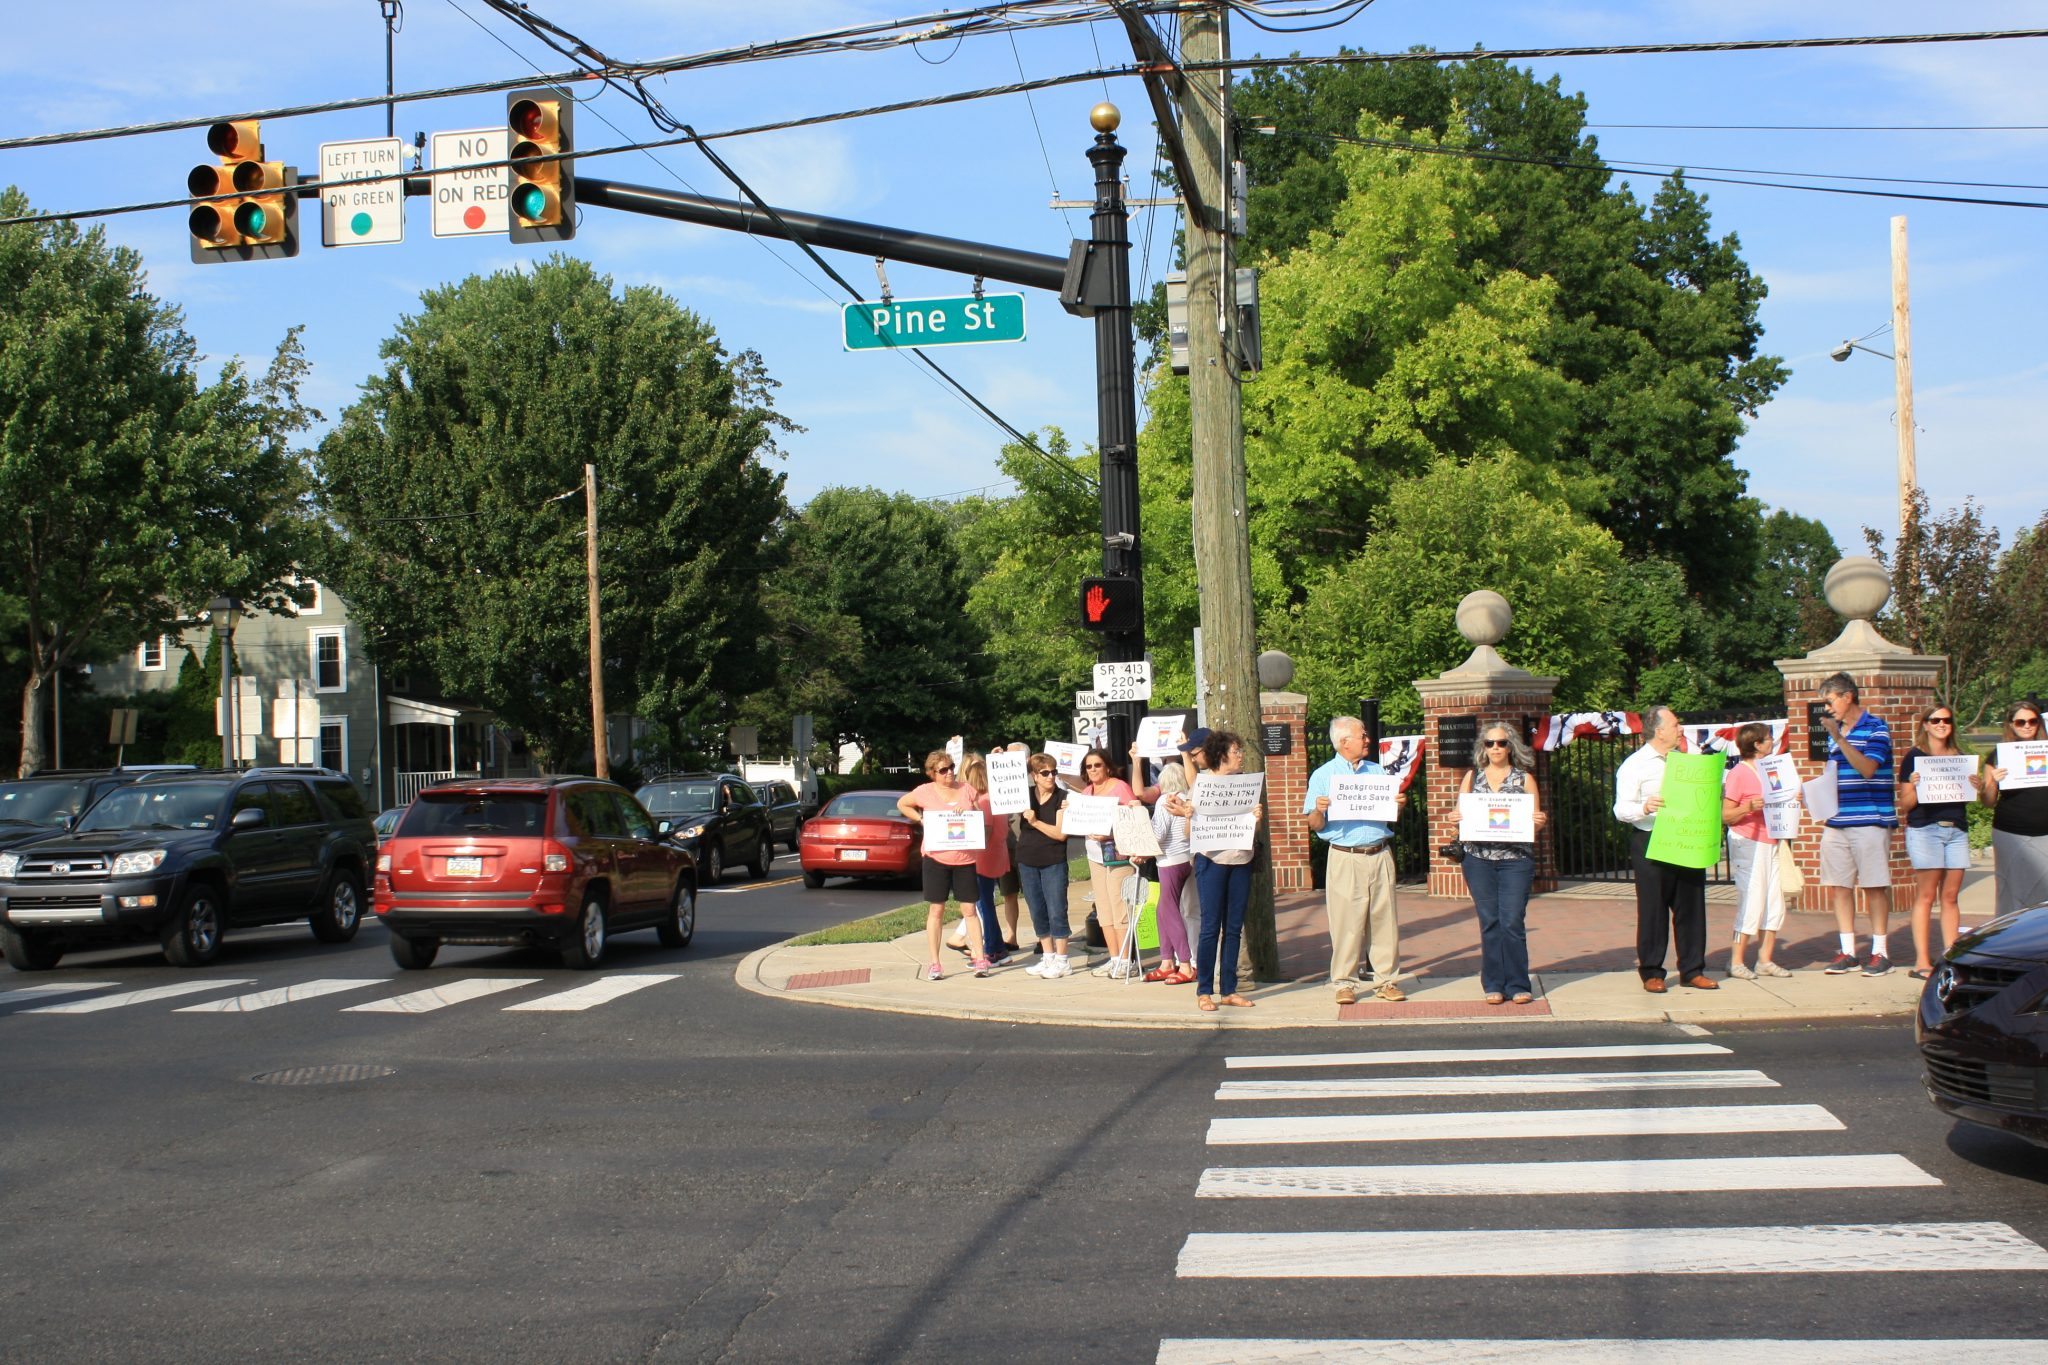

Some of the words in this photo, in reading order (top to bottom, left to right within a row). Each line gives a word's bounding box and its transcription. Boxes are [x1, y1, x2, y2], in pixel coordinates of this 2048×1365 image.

[459, 138, 488, 158] NO
[328, 152, 356, 167] LEFT
[363, 149, 394, 163] TURN
[438, 187, 463, 203] ON
[473, 184, 509, 201] RED
[330, 194, 346, 207] ON
[353, 191, 394, 205] GREEN
[872, 306, 946, 335] Pine
[964, 302, 996, 330] St
[1100, 665, 1115, 675] SR
[1124, 664, 1143, 674] 413
[1111, 677, 1134, 687] 220
[1111, 689, 1134, 699] 220
[1078, 717, 1107, 736] 21
[992, 760, 1022, 769] Bucks
[992, 773, 1025, 782] Against
[1339, 783, 1390, 791] Background
[1200, 790, 1255, 798] 215-638-1784
[1926, 793, 1966, 801] VIOLENCE
